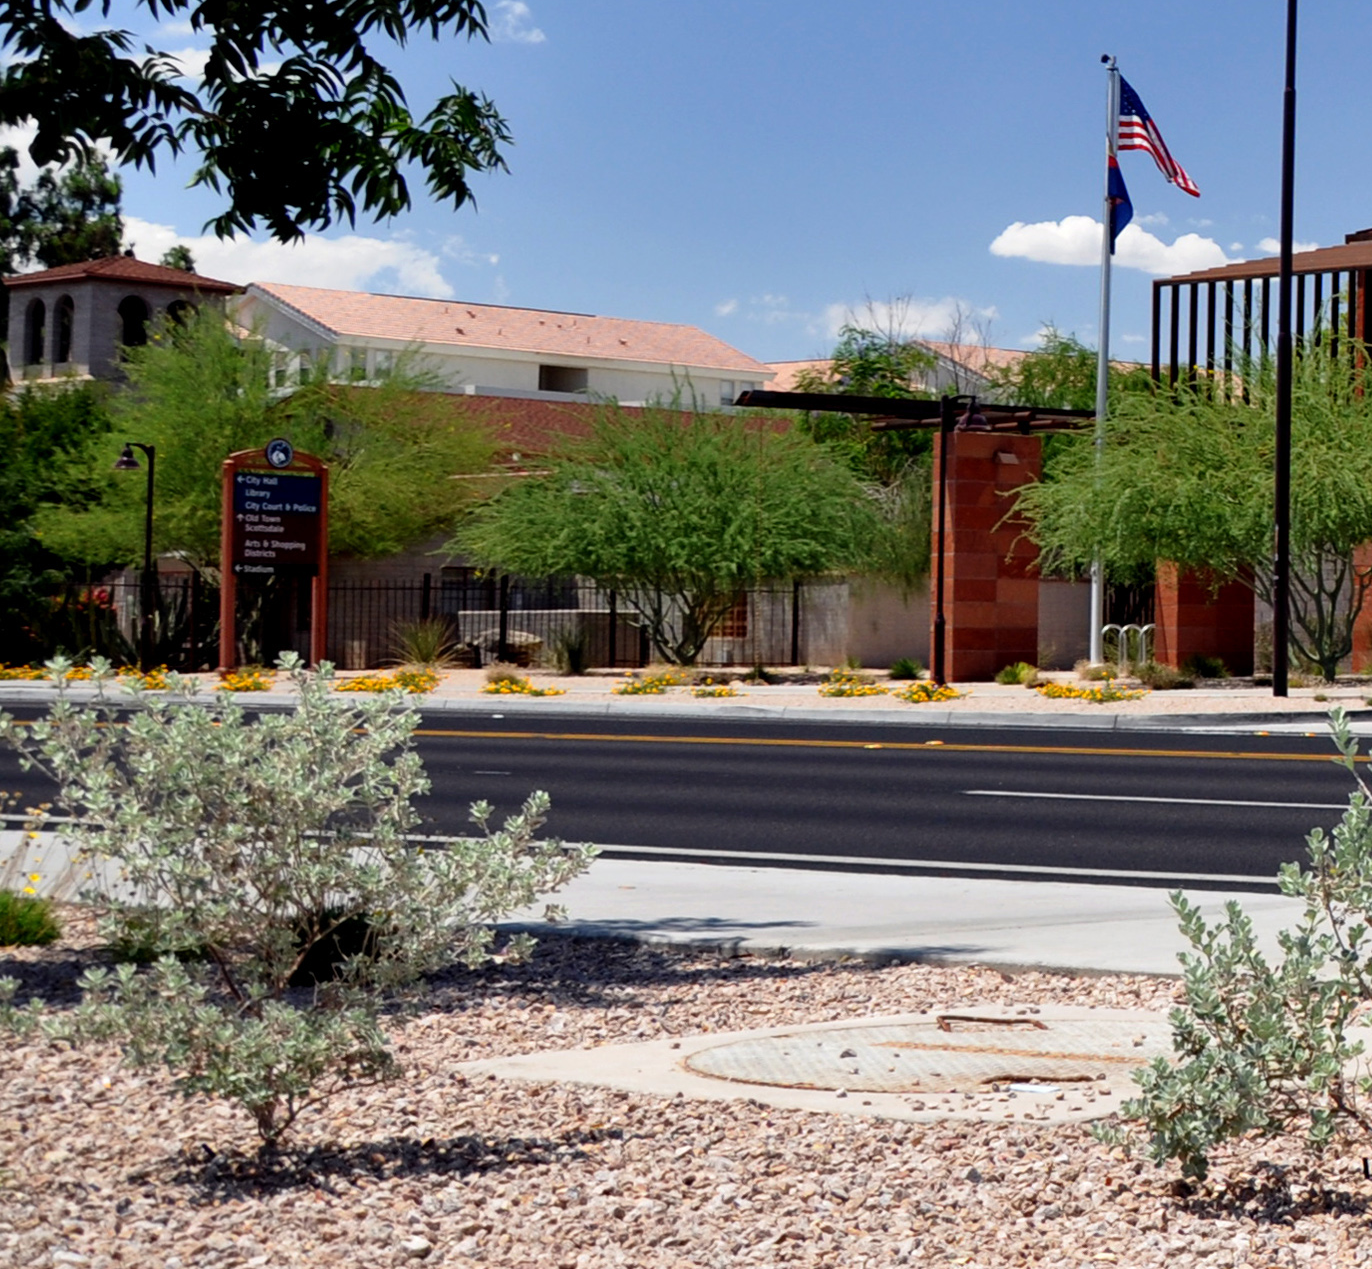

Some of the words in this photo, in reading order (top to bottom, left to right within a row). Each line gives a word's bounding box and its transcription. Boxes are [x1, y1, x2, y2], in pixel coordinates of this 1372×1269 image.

[245, 475, 261, 486] City
[262, 476, 279, 485] Hall
[245, 489, 271, 499] Library
[245, 501, 260, 511] City
[262, 502, 283, 511] Court
[285, 503, 291, 511] &
[293, 503, 317, 512] Police
[245, 514, 260, 522] Old
[261, 514, 282, 522] Town
[245, 523, 285, 533] Scottsdale
[244, 539, 261, 548] Arts
[263, 539, 269, 548] &
[271, 540, 306, 551] Shopping
[244, 549, 276, 558] Districts
[243, 564, 275, 573] Stadium
